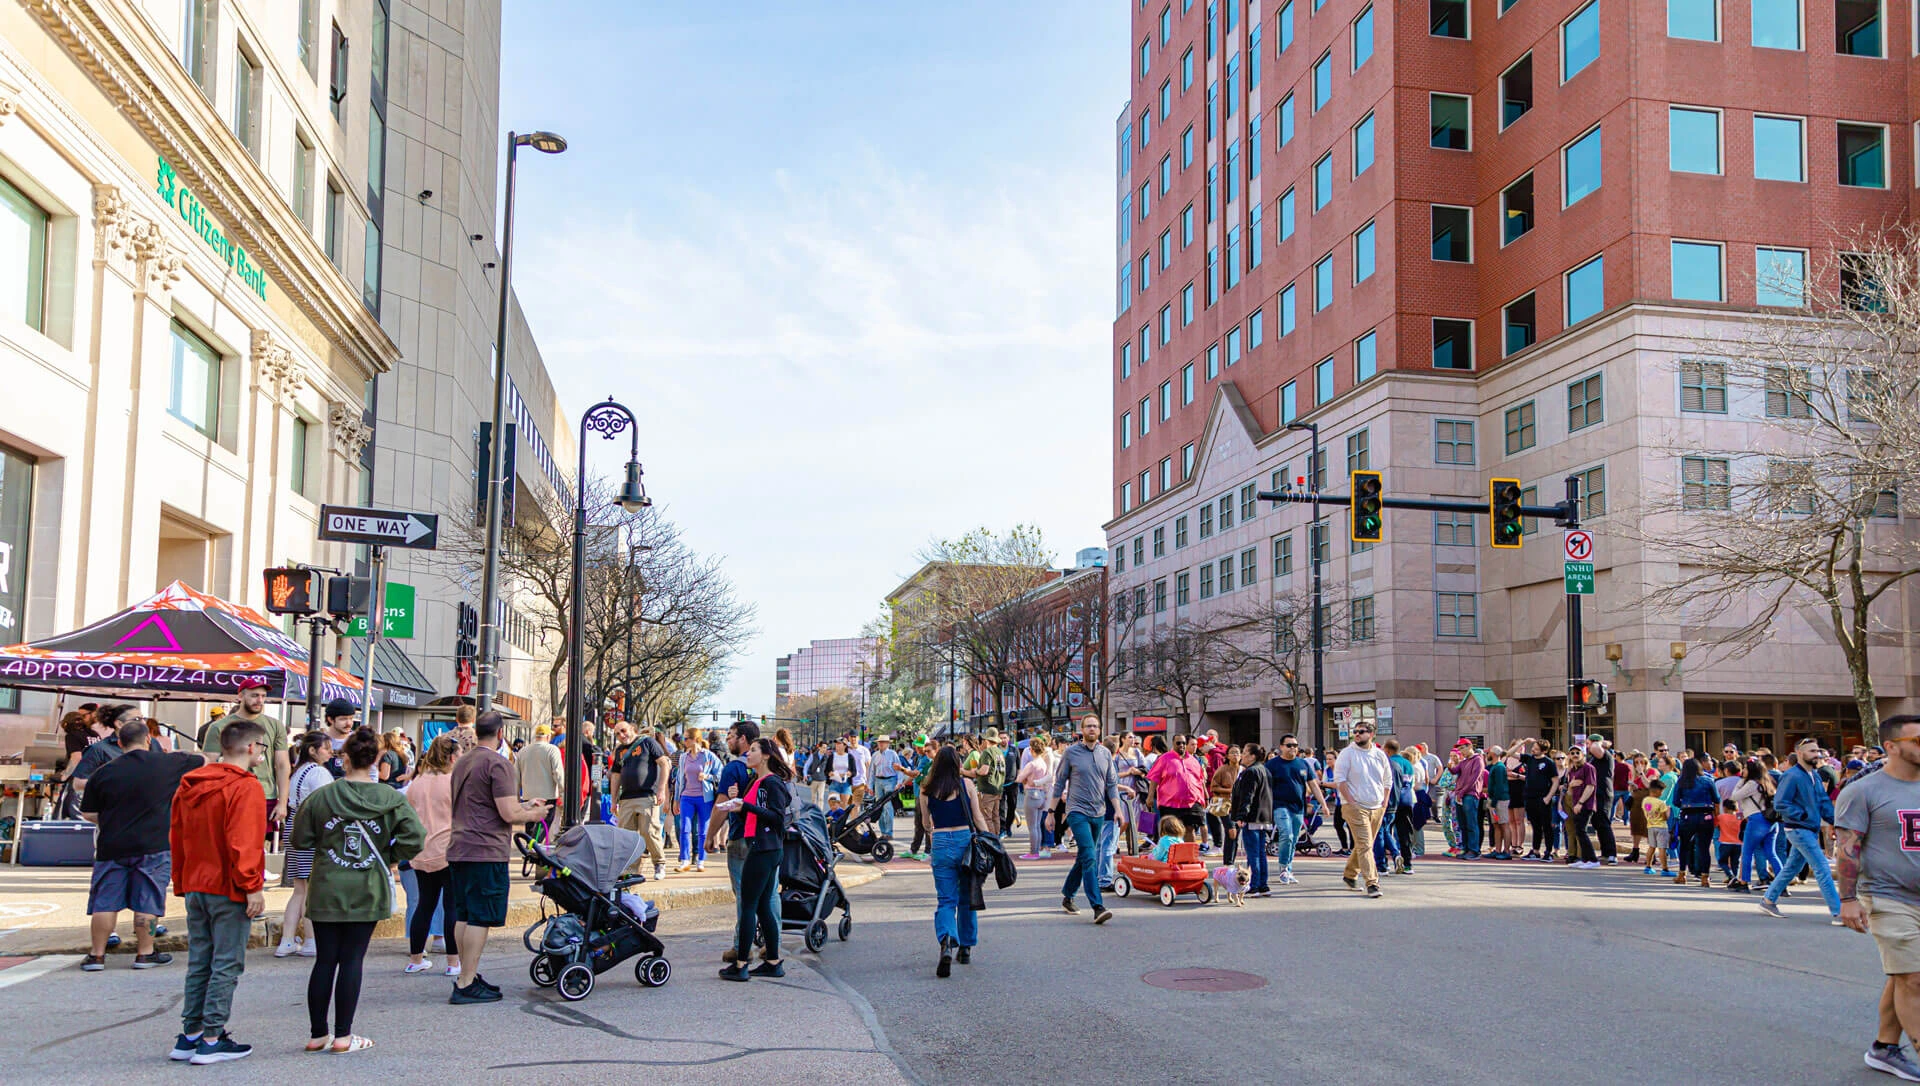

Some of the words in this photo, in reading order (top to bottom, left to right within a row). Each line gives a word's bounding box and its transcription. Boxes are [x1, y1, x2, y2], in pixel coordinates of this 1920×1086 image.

[179, 188, 235, 268] Citizens
[237, 247, 267, 302] Bank
[333, 516, 367, 532] ONE
[376, 520, 411, 536] WAY
[1566, 564, 1592, 573] SNHU
[327, 848, 351, 868] BREW
